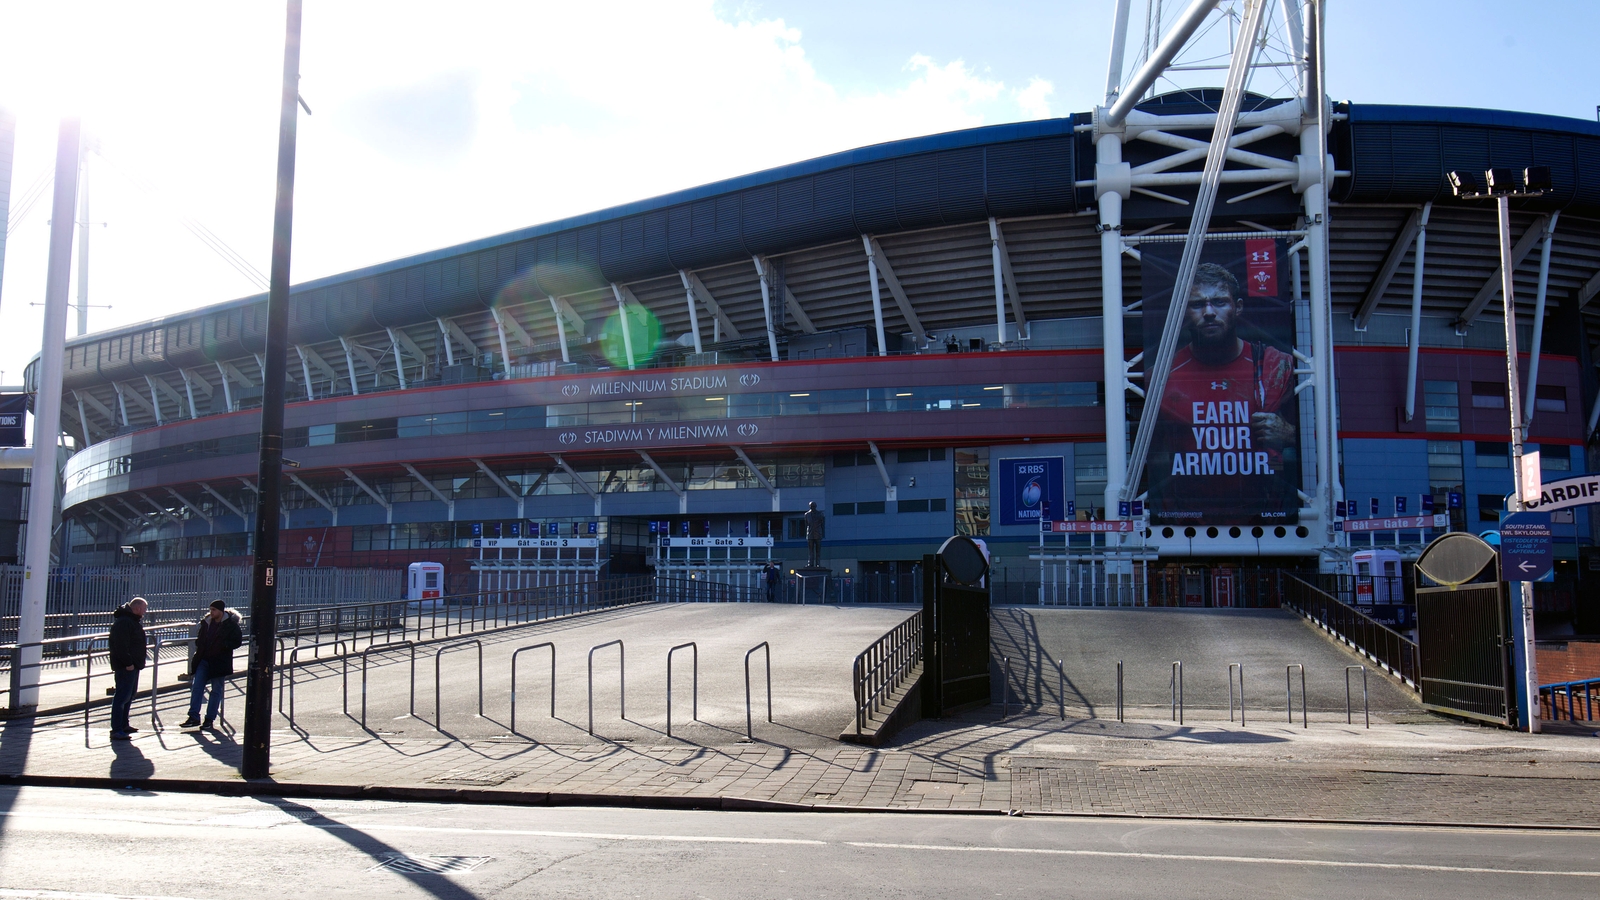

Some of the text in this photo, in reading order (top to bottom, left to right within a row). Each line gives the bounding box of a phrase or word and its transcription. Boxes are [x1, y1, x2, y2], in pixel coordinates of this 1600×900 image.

[590, 376, 728, 396] MILLENNIUM STADIUM
[1192, 401, 1249, 424] EARN
[584, 425, 728, 444] STADIWM Y MILENIWM
[1192, 426, 1252, 450] YOUR
[1028, 465, 1044, 474] RBS
[1172, 452, 1274, 476] ARMOUR.
[1527, 467, 1534, 487] 2
[1018, 510, 1044, 518] NATION
[1384, 519, 1408, 528] Gate
[1416, 517, 1424, 527] 2
[1090, 522, 1113, 530] Gate
[1120, 522, 1127, 531] 2
